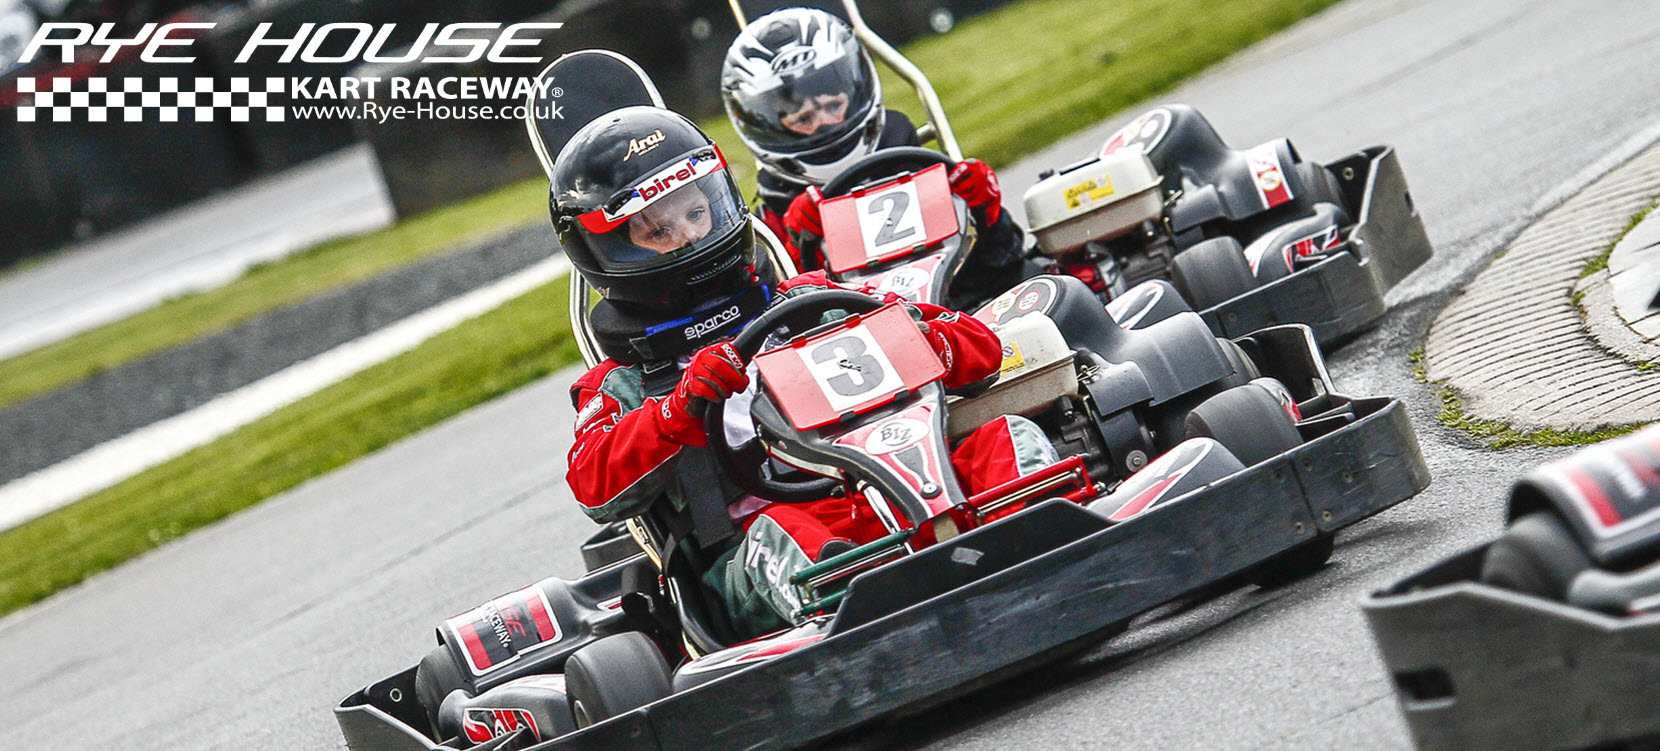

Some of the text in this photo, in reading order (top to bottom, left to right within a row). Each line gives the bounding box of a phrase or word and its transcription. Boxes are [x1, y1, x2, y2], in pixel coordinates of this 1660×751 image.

[623, 129, 666, 162] Arai
[639, 162, 697, 202] birel
[868, 191, 916, 247] 2
[684, 305, 741, 340] sparco
[811, 336, 885, 396] 3
[880, 427, 912, 442] BIZ
[745, 530, 790, 590] irel
